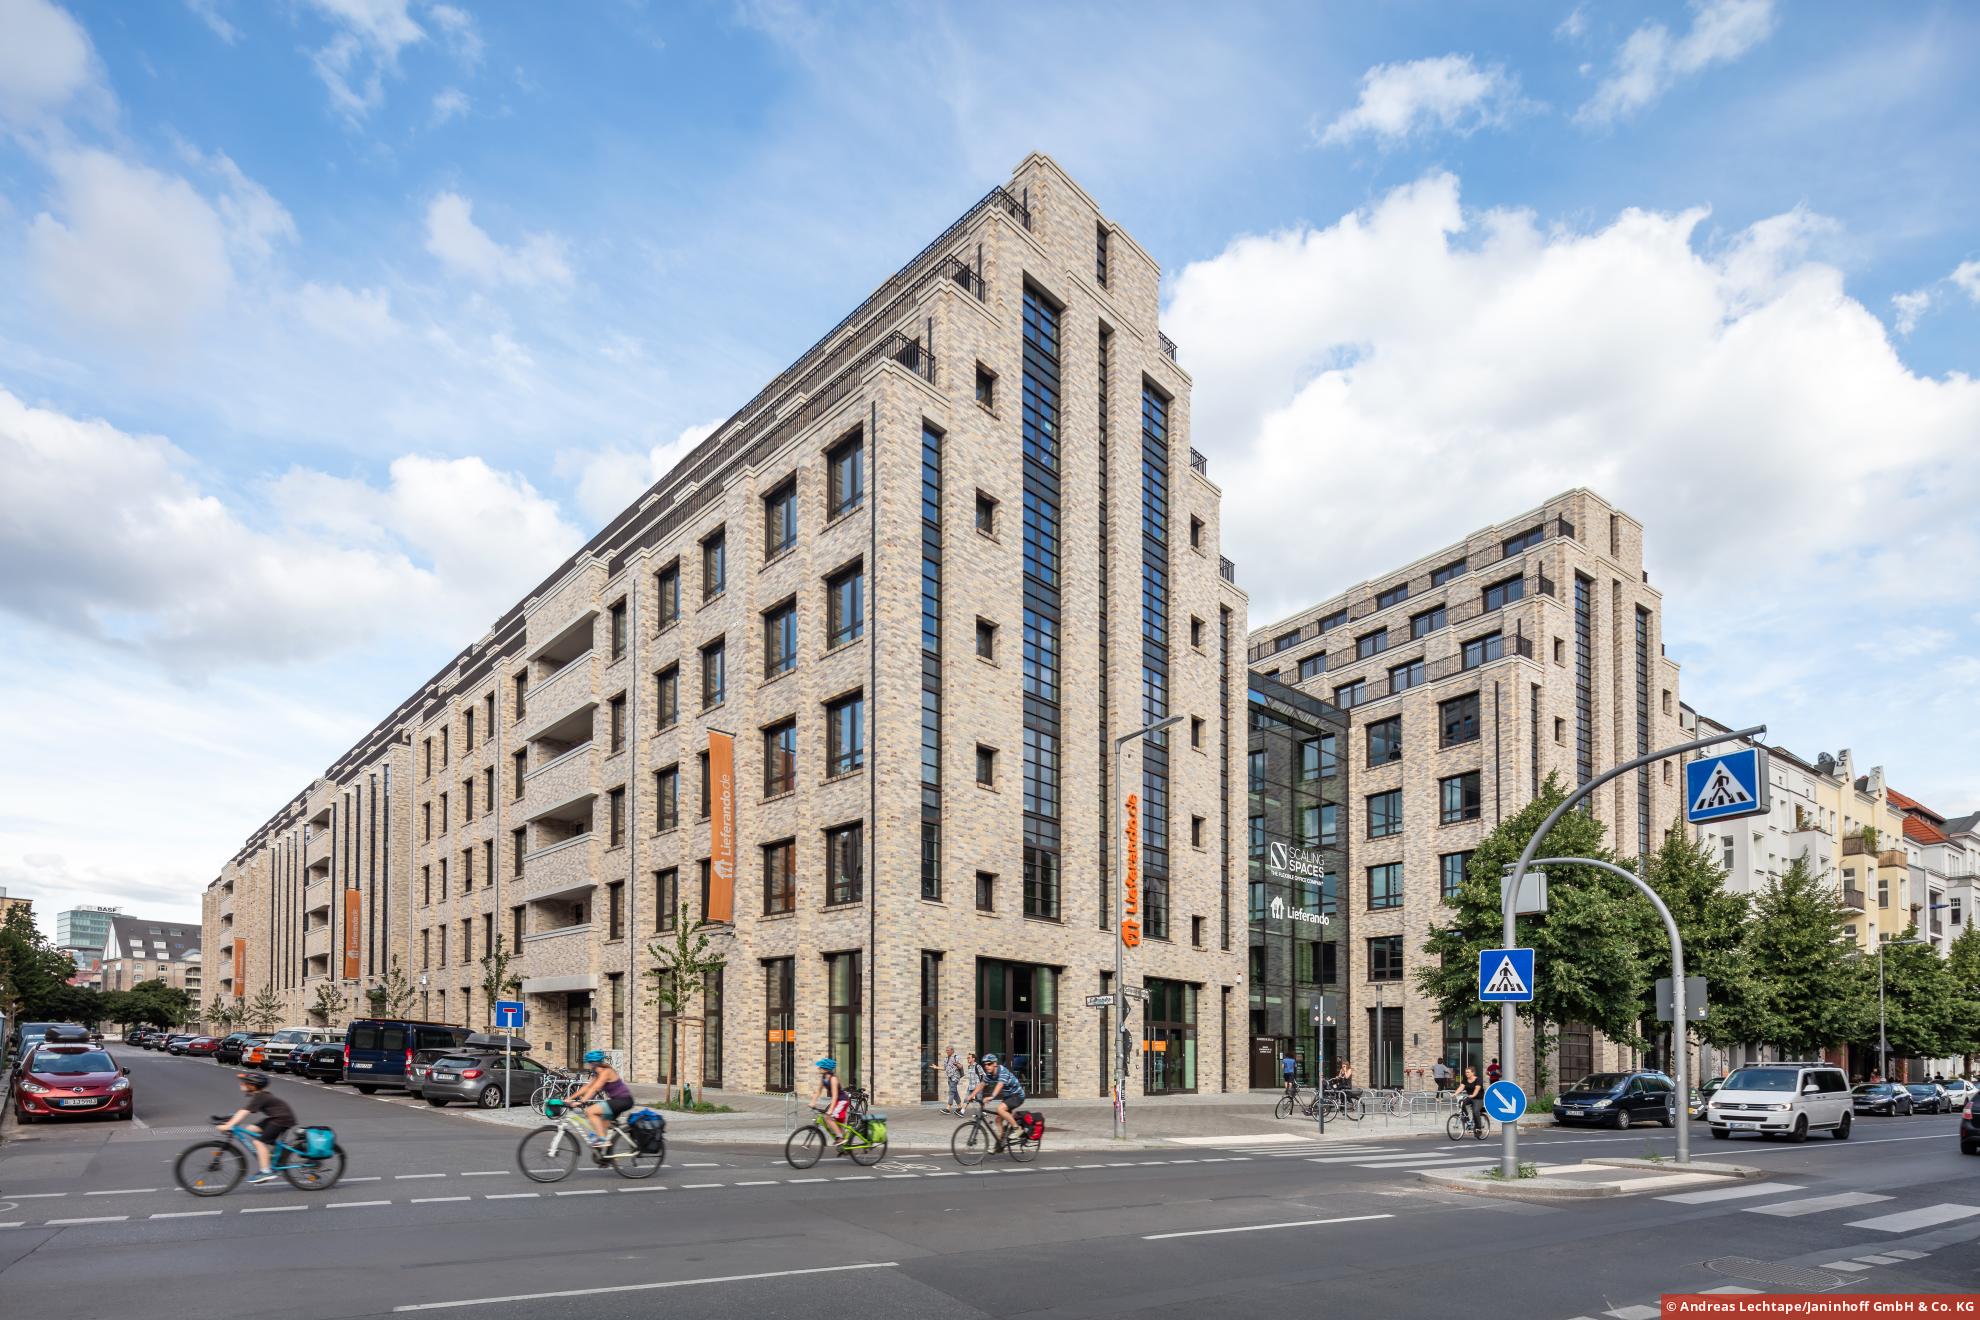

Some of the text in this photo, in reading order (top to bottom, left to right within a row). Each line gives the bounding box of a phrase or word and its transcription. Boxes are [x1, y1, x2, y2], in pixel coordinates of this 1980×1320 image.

[1289, 847, 1324, 866] SCALING
[1289, 860, 1324, 878] SPACES
[1287, 906, 1329, 925] Lieferando
